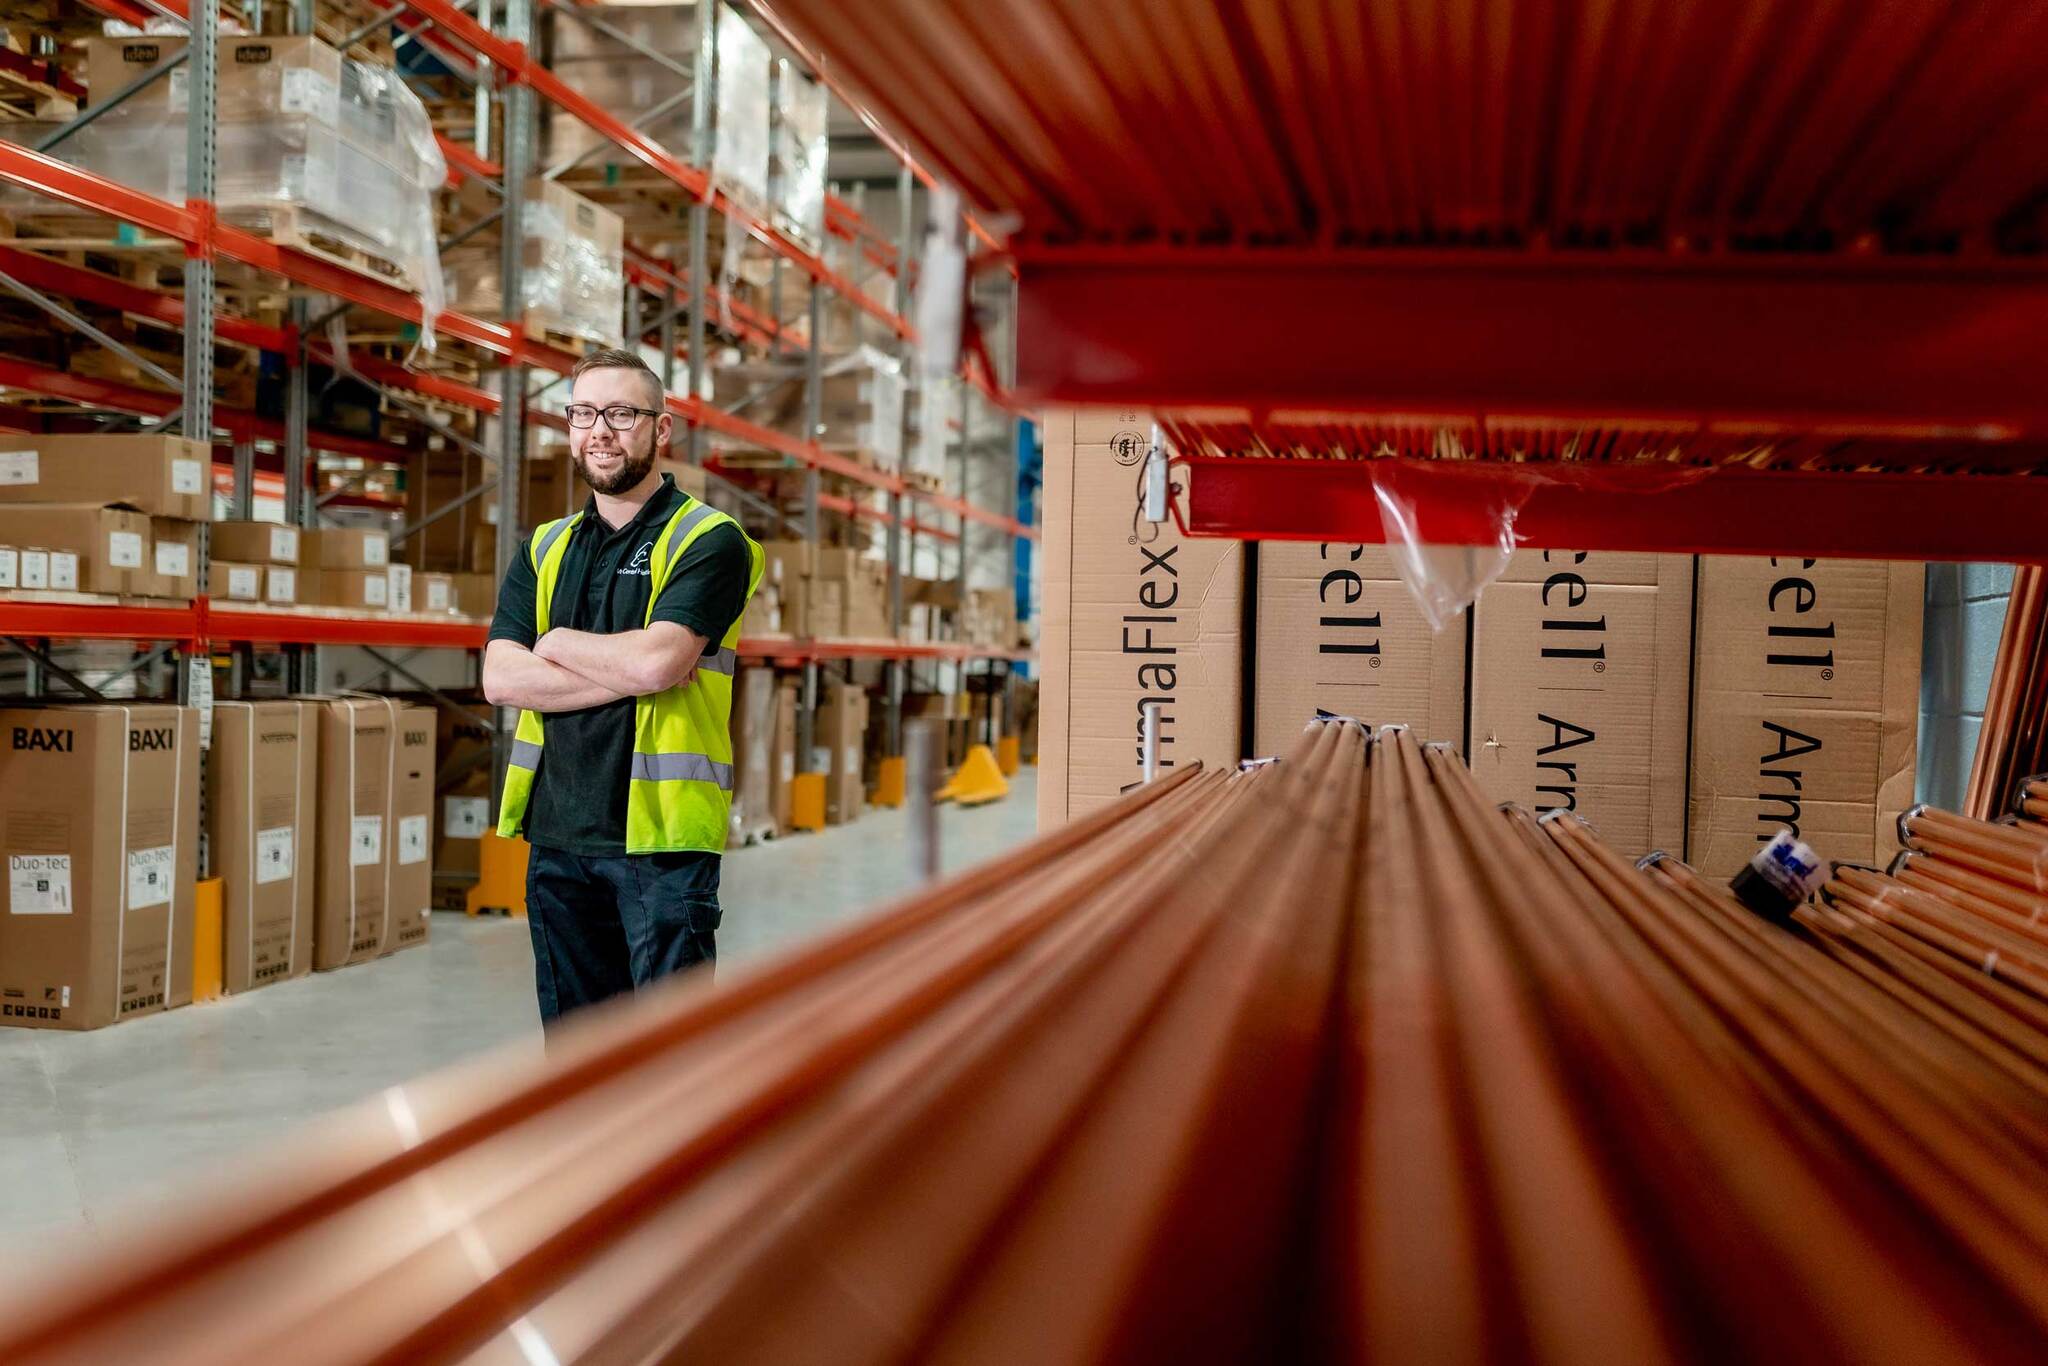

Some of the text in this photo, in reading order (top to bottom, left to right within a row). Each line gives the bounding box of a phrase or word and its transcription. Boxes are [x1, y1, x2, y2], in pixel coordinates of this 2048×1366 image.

[1120, 536, 1178, 794] rmaFlex®
[12, 727, 74, 752] BAXI
[129, 728, 174, 751] BAXI
[12, 855, 69, 871] Duo-tec
[130, 848, 171, 867] Duo-tec
